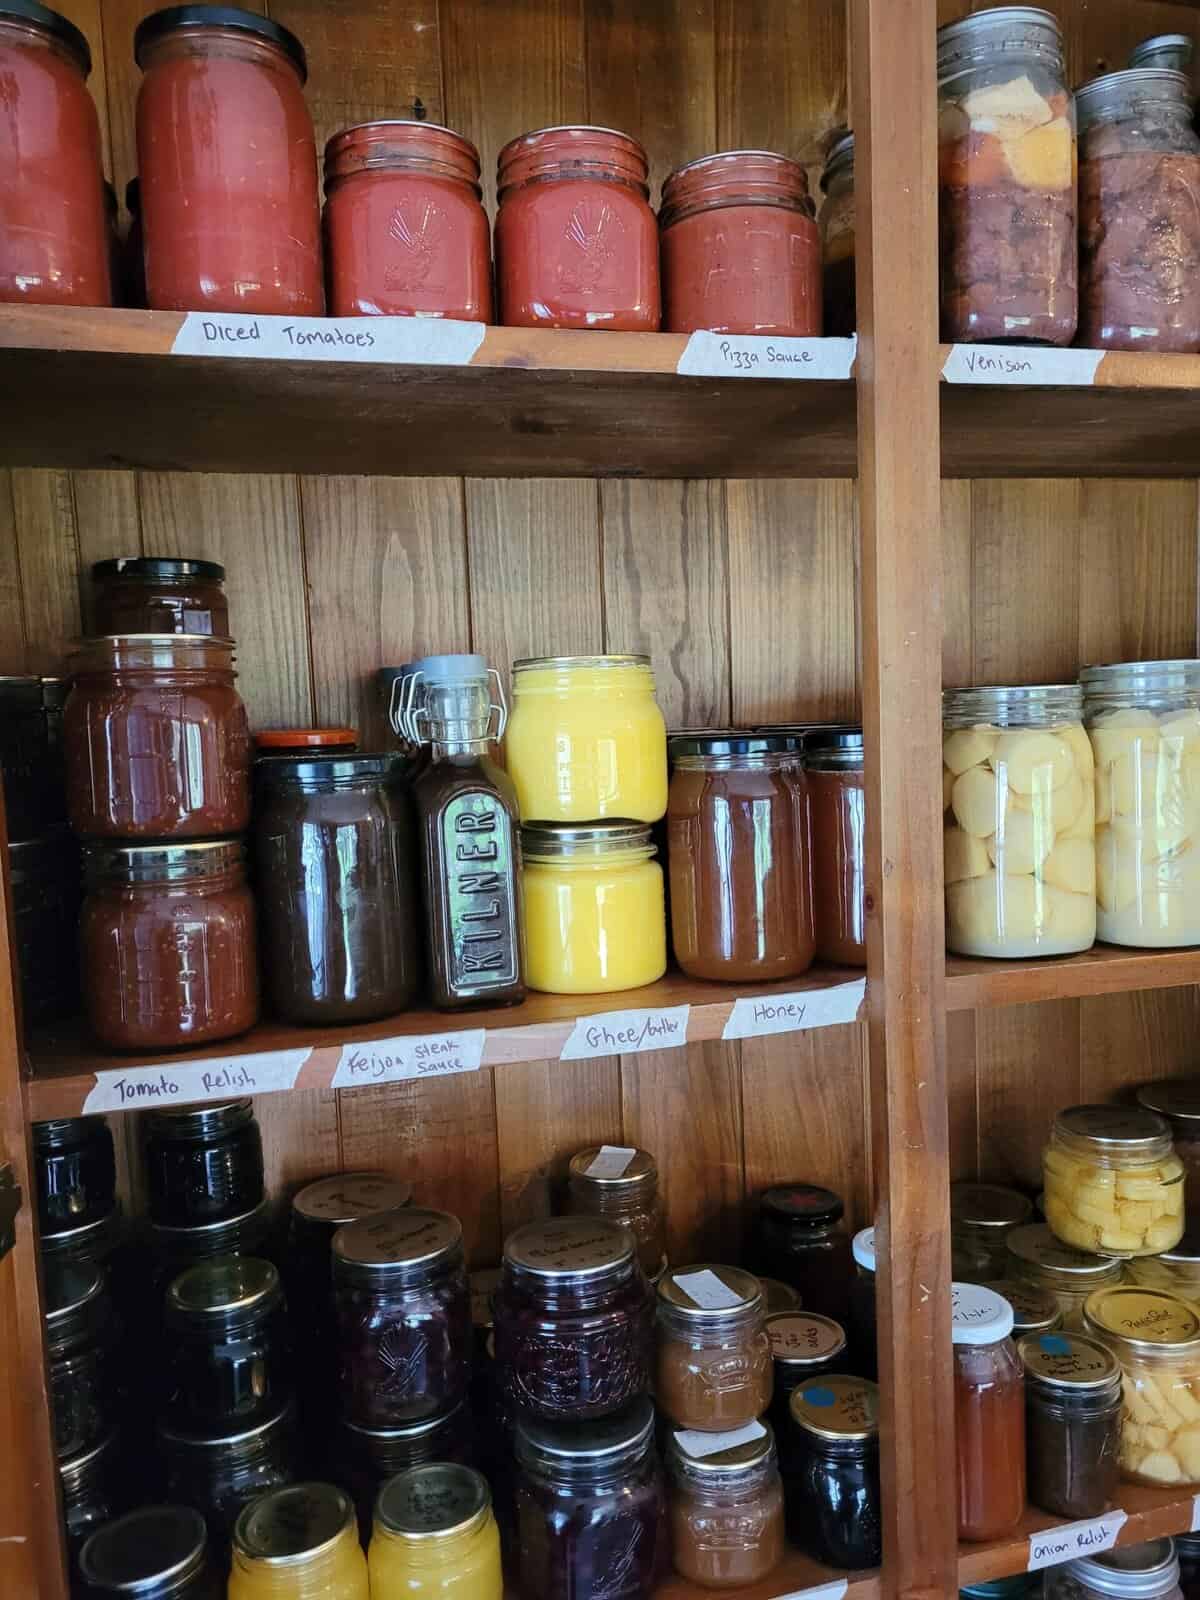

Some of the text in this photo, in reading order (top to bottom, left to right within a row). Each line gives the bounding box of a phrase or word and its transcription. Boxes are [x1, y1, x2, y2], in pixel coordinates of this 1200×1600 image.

[202, 321, 375, 347] Diced Tomatoes
[720, 341, 813, 369] Pizza Sauce
[966, 351, 1033, 373] Venison
[455, 811, 505, 974] KILNER
[753, 1003, 806, 1024] Honey
[113, 1064, 256, 1103] Tomato Relish
